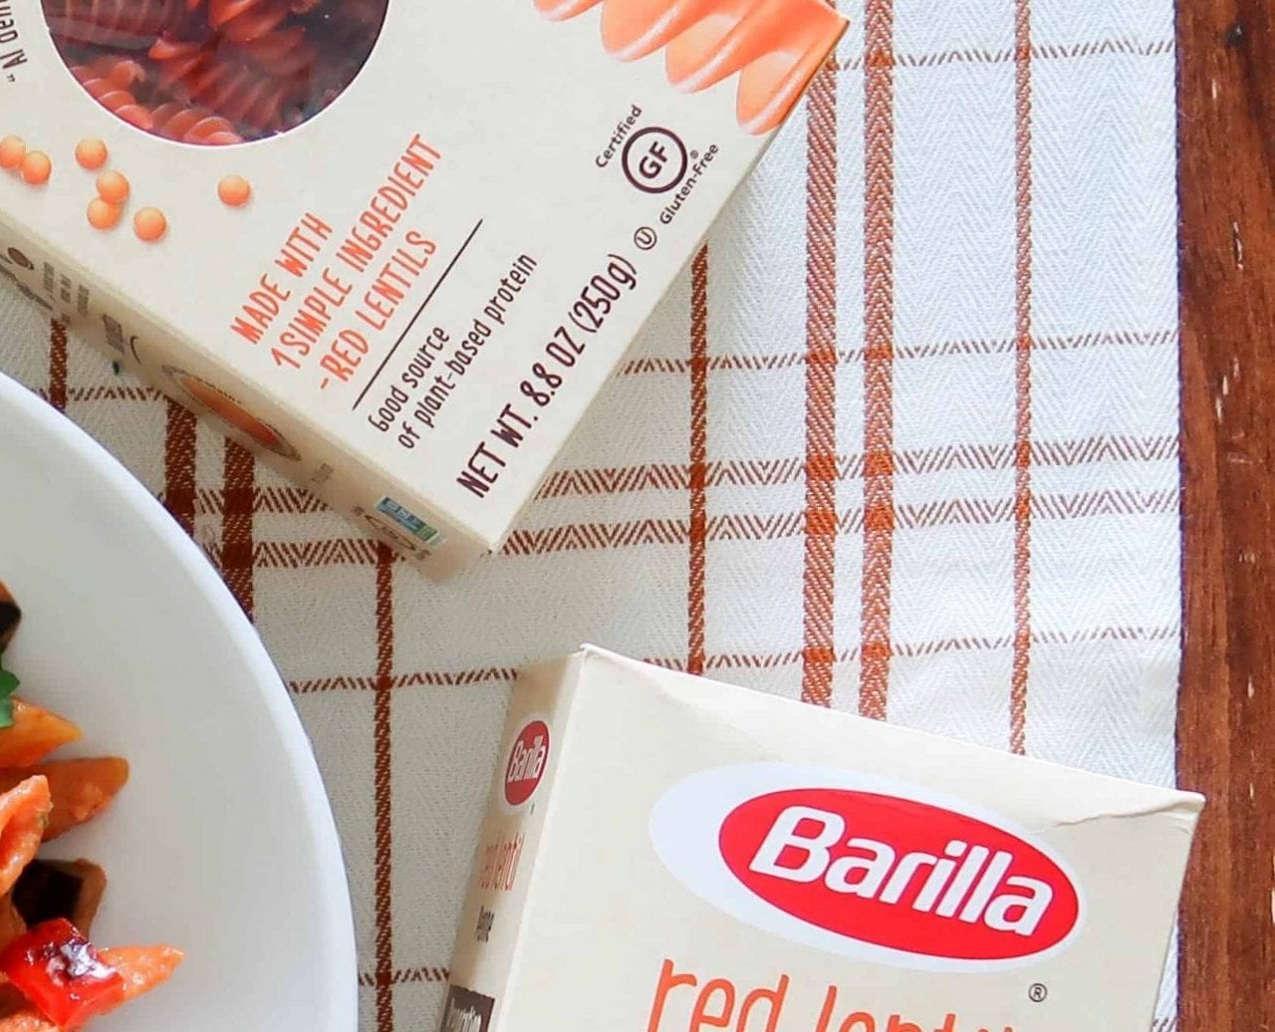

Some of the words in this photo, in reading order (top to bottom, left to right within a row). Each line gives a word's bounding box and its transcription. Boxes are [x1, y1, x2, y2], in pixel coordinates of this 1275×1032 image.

[596, 105, 642, 168] Certified
[638, 140, 670, 181] GF
[660, 145, 719, 224] Gluten-Free
[336, 134, 441, 272] INGREDIENT
[231, 274, 290, 344] MADE
[275, 213, 332, 277] WITH
[356, 231, 436, 330] LENTILS
[368, 385, 409, 432] Good
[402, 327, 450, 388] source
[398, 421, 420, 449] of
[414, 319, 492, 428] plant-based
[484, 255, 537, 325] protein
[456, 441, 506, 498] NET
[490, 403, 538, 448] WT.
[520, 362, 562, 407] 8.8
[546, 326, 585, 367] OZ
[568, 254, 637, 333] (250g)
[748, 804, 1054, 936] Barilla
